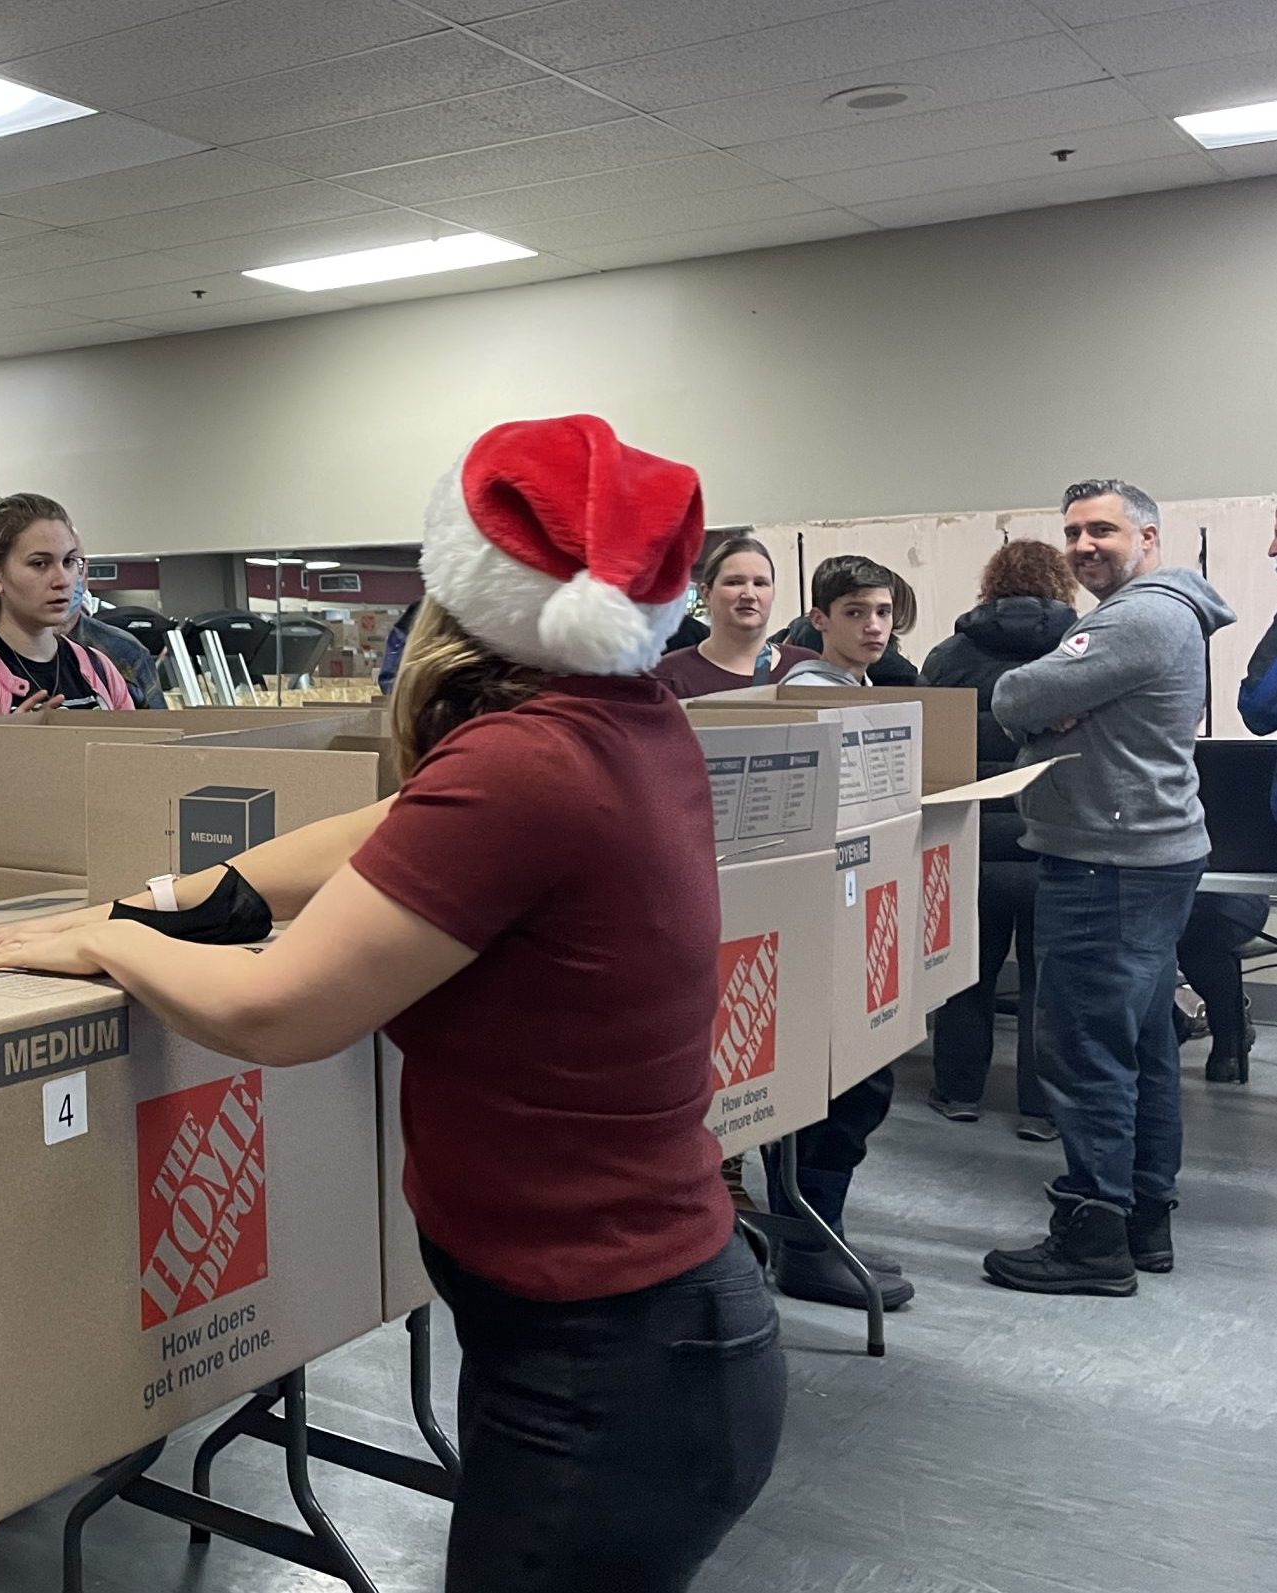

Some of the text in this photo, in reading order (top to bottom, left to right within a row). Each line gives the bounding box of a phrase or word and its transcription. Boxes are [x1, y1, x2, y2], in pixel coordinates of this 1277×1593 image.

[191, 831, 232, 845] MEDIUM
[837, 840, 869, 866] OYENNE
[4, 1017, 119, 1075] MEDIUM
[57, 1093, 74, 1128] 4
[721, 1086, 768, 1116] How doers
[728, 1111, 751, 1133] more
[151, 1111, 204, 1202] THE
[141, 1072, 263, 1319] HOME
[193, 1147, 266, 1302] DEPOT
[161, 1303, 256, 1362] How doers
[143, 1329, 275, 1410] get more done.
